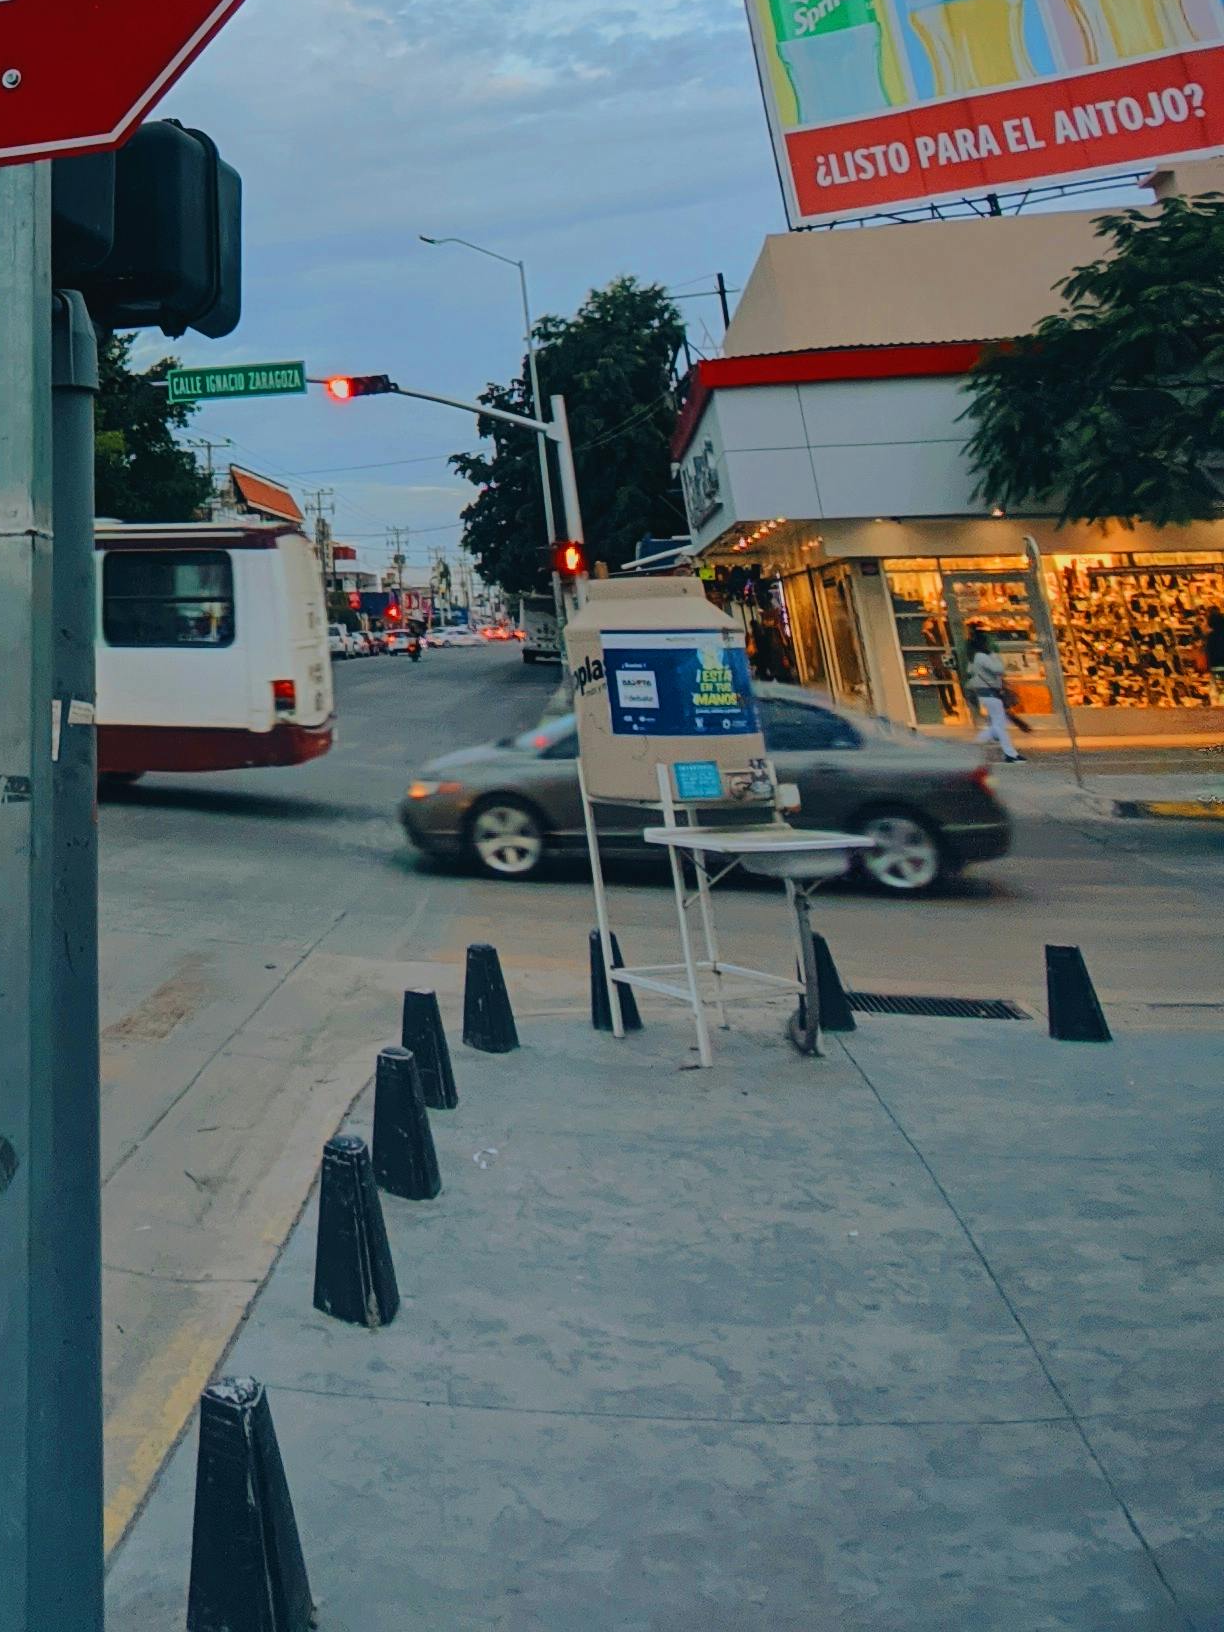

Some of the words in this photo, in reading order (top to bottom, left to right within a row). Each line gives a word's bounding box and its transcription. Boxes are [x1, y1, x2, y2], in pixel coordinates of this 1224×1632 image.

[816, 142, 910, 187] ¿LISTO
[915, 124, 1002, 169] PARA
[1002, 116, 1046, 153] EL
[1054, 82, 1205, 145] ANTOJO?
[173, 376, 203, 395] CALLE
[206, 373, 245, 393] IGNACIO
[248, 369, 301, 390] ZARAGOZA
